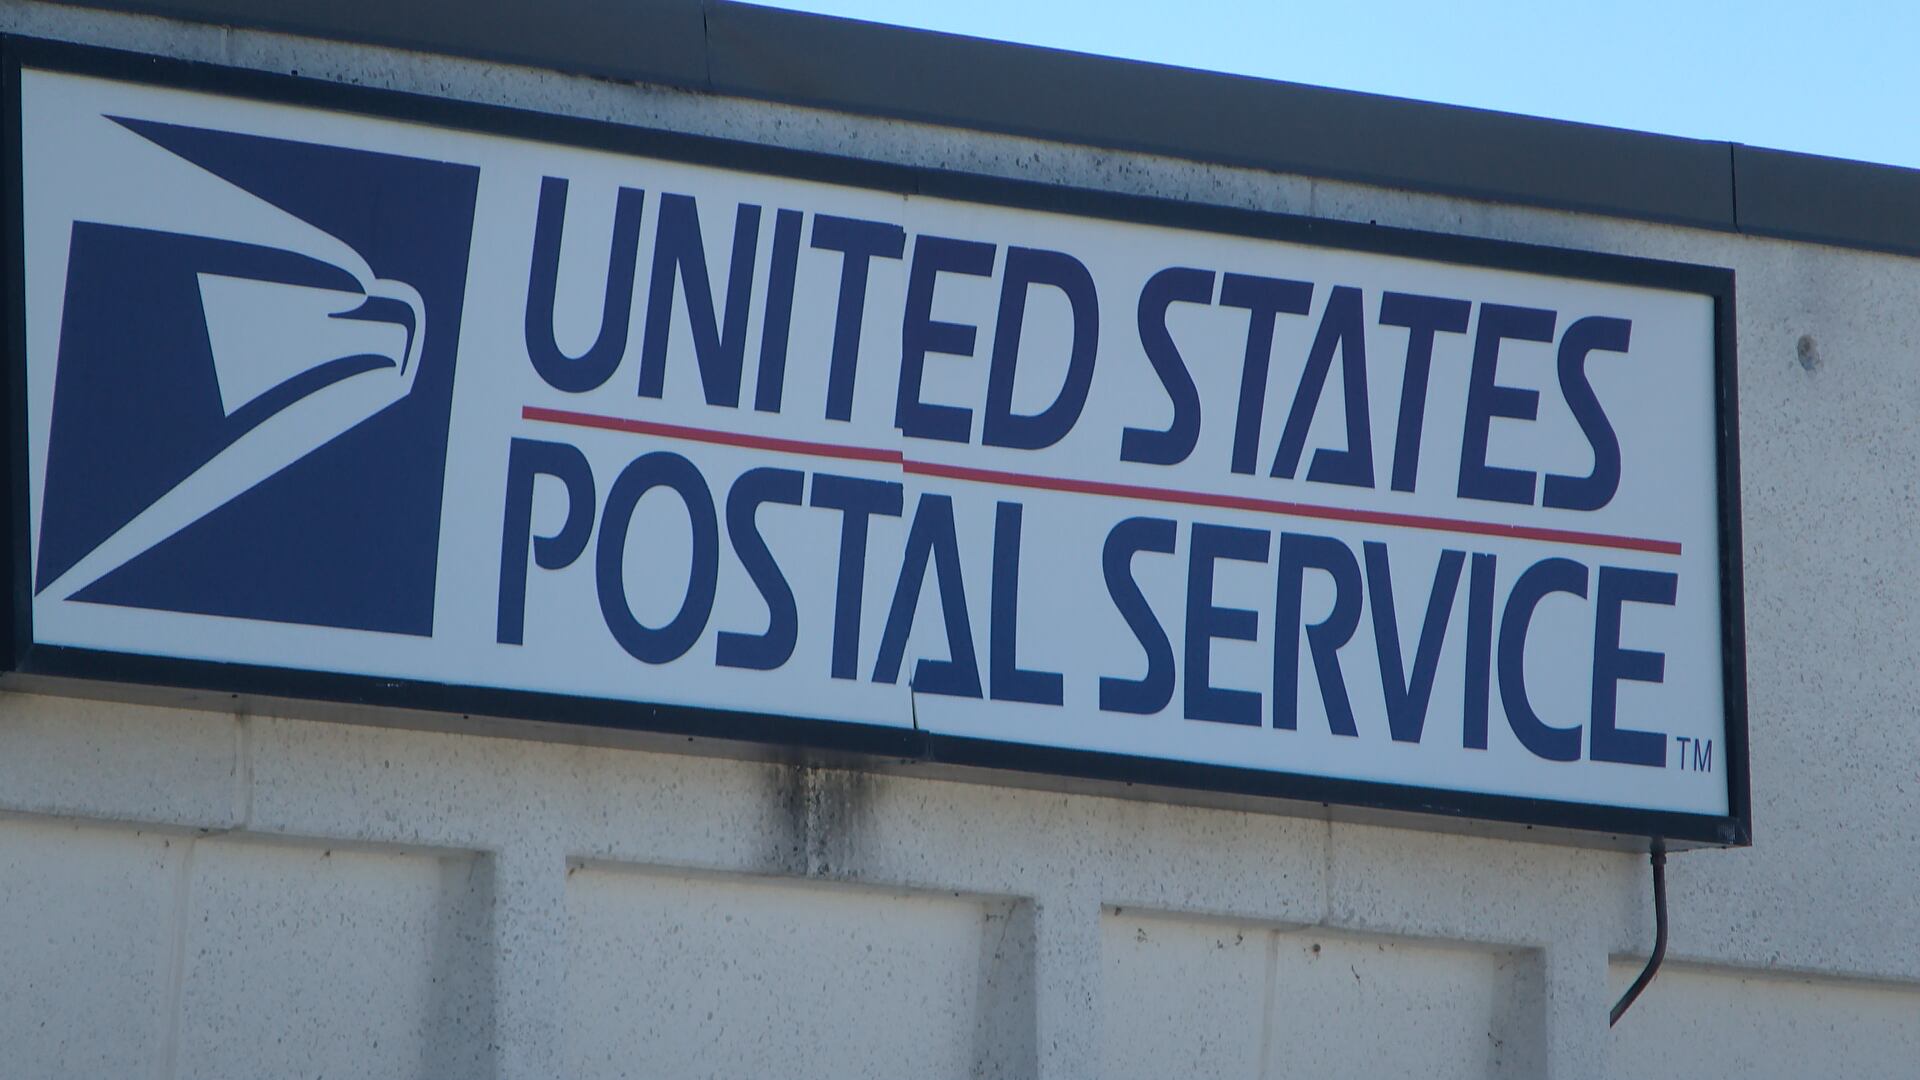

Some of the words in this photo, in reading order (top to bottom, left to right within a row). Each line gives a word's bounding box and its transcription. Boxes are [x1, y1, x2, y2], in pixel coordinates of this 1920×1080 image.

[524, 175, 1100, 451] UNITED
[1120, 265, 1633, 512] STATES
[496, 437, 1064, 707] POSTAL
[1099, 516, 1679, 768] SERVICE
[1676, 736, 1713, 773] TM
